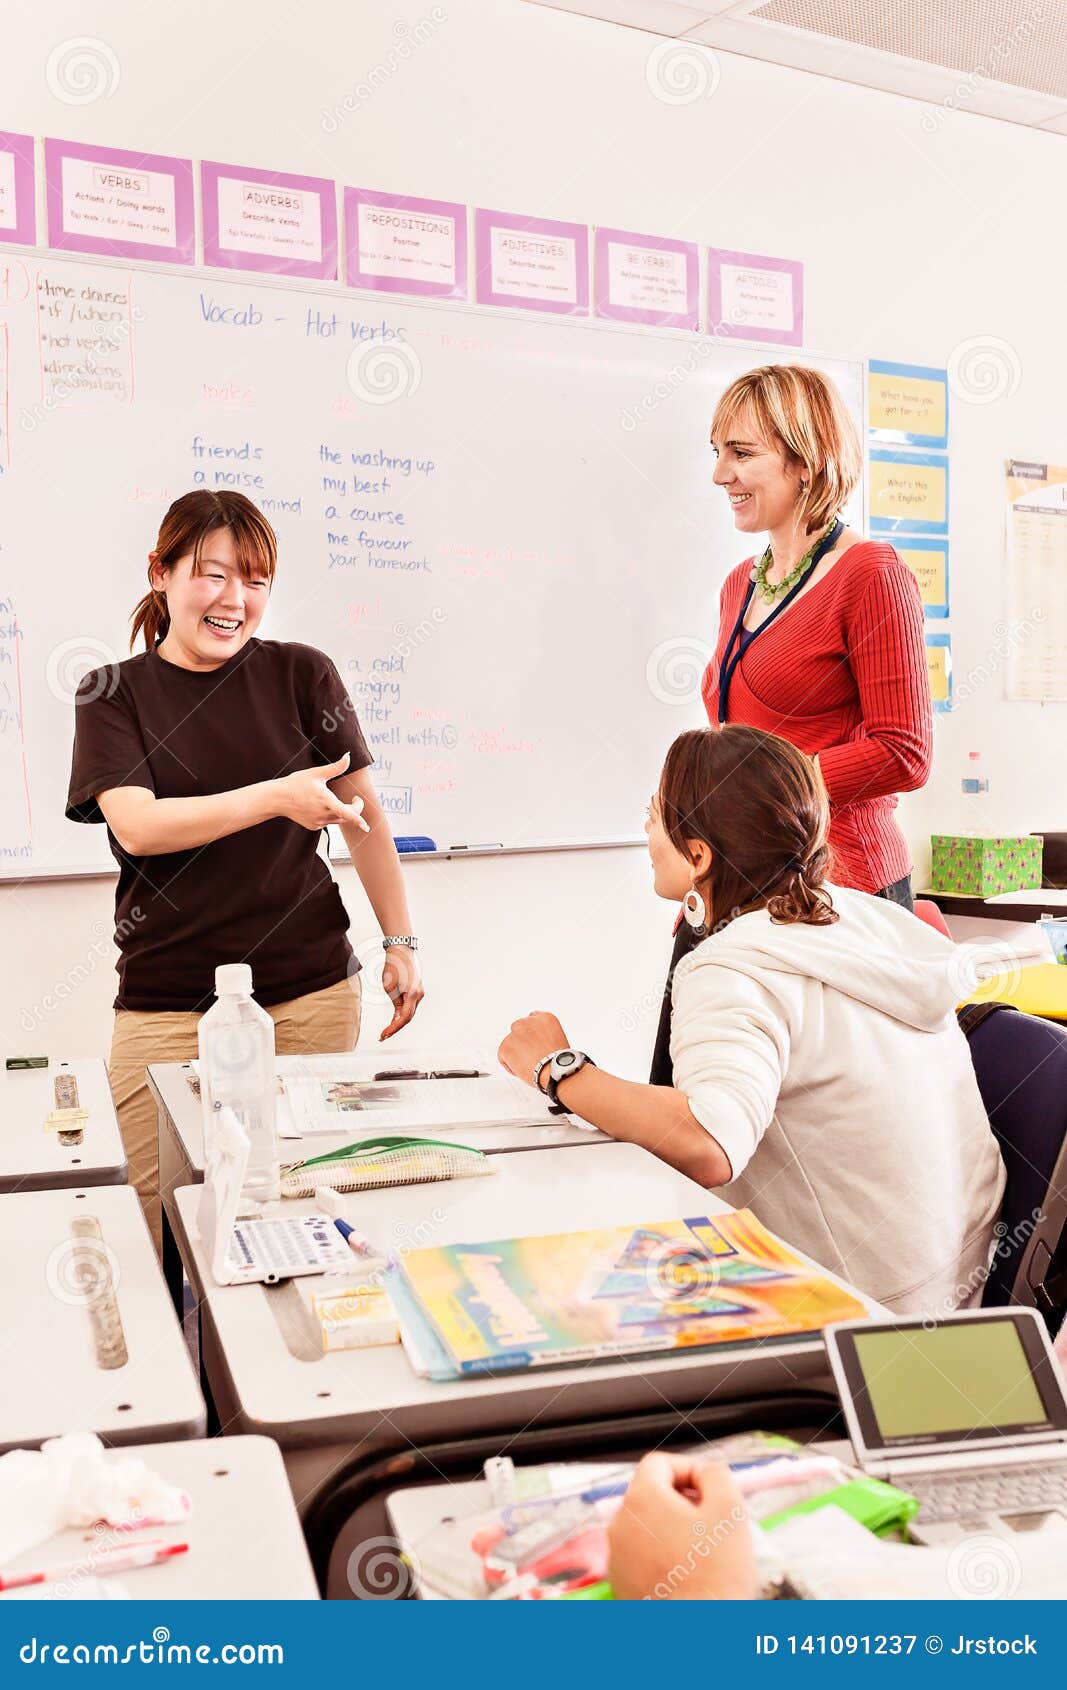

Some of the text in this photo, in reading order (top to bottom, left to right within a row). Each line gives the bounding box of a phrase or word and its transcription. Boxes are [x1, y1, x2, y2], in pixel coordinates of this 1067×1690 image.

[99, 174, 142, 191] VERBS
[74, 192, 106, 204] Actions
[116, 198, 140, 211] Doing
[142, 204, 167, 214] words
[246, 192, 300, 211] ADVERBS
[242, 211, 276, 225] Describe
[367, 213, 450, 236] PREPOSITIONS
[501, 239, 565, 257] ADJECTIVES
[44, 279, 75, 298] time
[200, 294, 263, 326] Vocab
[305, 308, 340, 337] Hot
[350, 320, 408, 343] verbs
[190, 435, 263, 461] friends
[318, 444, 436, 477] the washing up
[192, 470, 265, 489] a noise
[322, 475, 392, 496] my best
[260, 497, 302, 517] mind
[325, 505, 405, 525] a course
[327, 531, 415, 551] me favour
[328, 553, 359, 571] your
[368, 551, 432, 574] homework
[370, 726, 400, 746] well
[378, 791, 408, 812] hool
